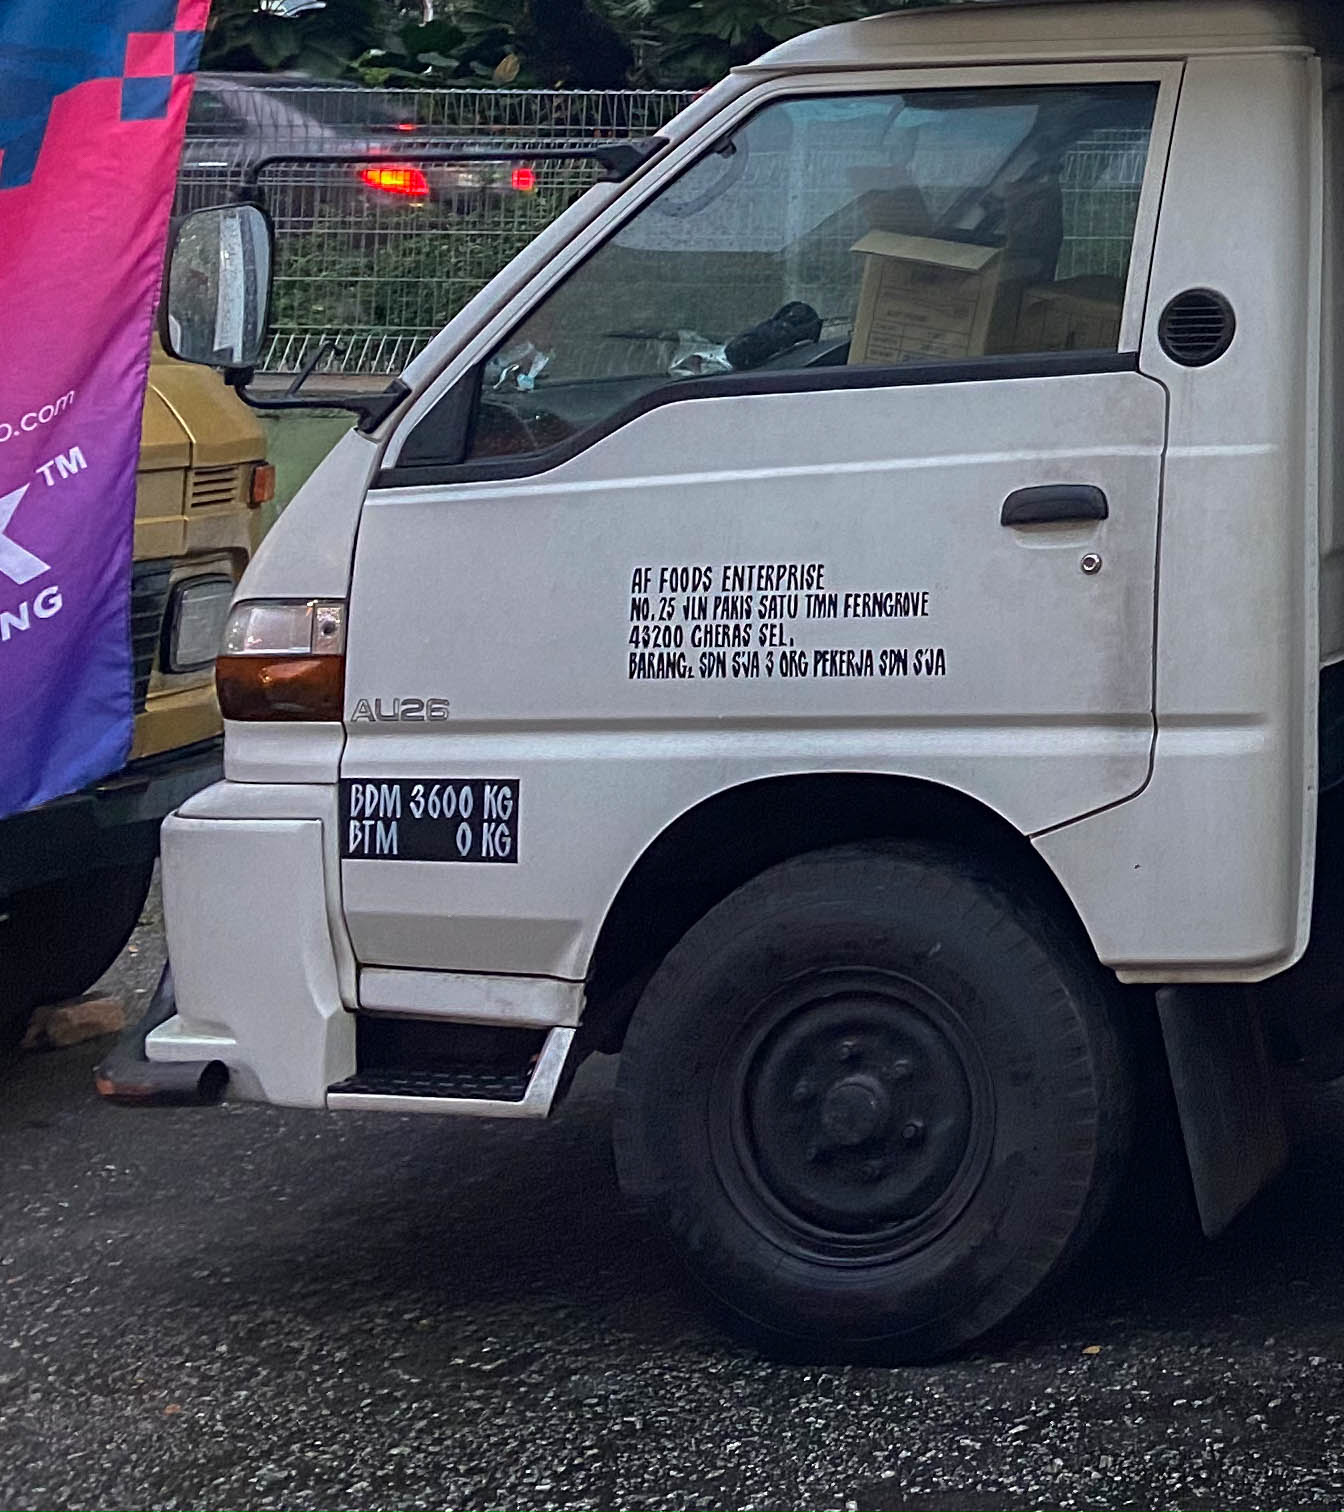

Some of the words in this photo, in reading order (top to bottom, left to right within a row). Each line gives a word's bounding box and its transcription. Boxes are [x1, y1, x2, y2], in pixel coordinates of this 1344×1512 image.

[631, 567, 652, 593] AF
[659, 566, 713, 593] FOODS
[721, 564, 825, 592] ENTERPRISE
[630, 597, 655, 621] NO.
[658, 597, 675, 621] 25
[683, 595, 708, 620] JLN
[713, 595, 753, 620] PAKIS
[758, 594, 799, 619] SATU
[805, 593, 838, 618] TMN
[843, 592, 929, 617] FERNGROVE
[629, 624, 683, 648] 43200
[758, 622, 794, 647] SEL.
[699, 651, 727, 678] SDN
[765, 651, 774, 678] 3
[779, 650, 808, 677] ORG
[813, 649, 873, 677] PEKERJA
[879, 649, 907, 676] SDN
[351, 698, 450, 722] AU26
[350, 784, 401, 818] BDM
[409, 784, 473, 819] 3600
[484, 784, 513, 820] KG
[349, 819, 398, 855] BTM
[456, 821, 472, 856] 0
[481, 822, 511, 857] KG
